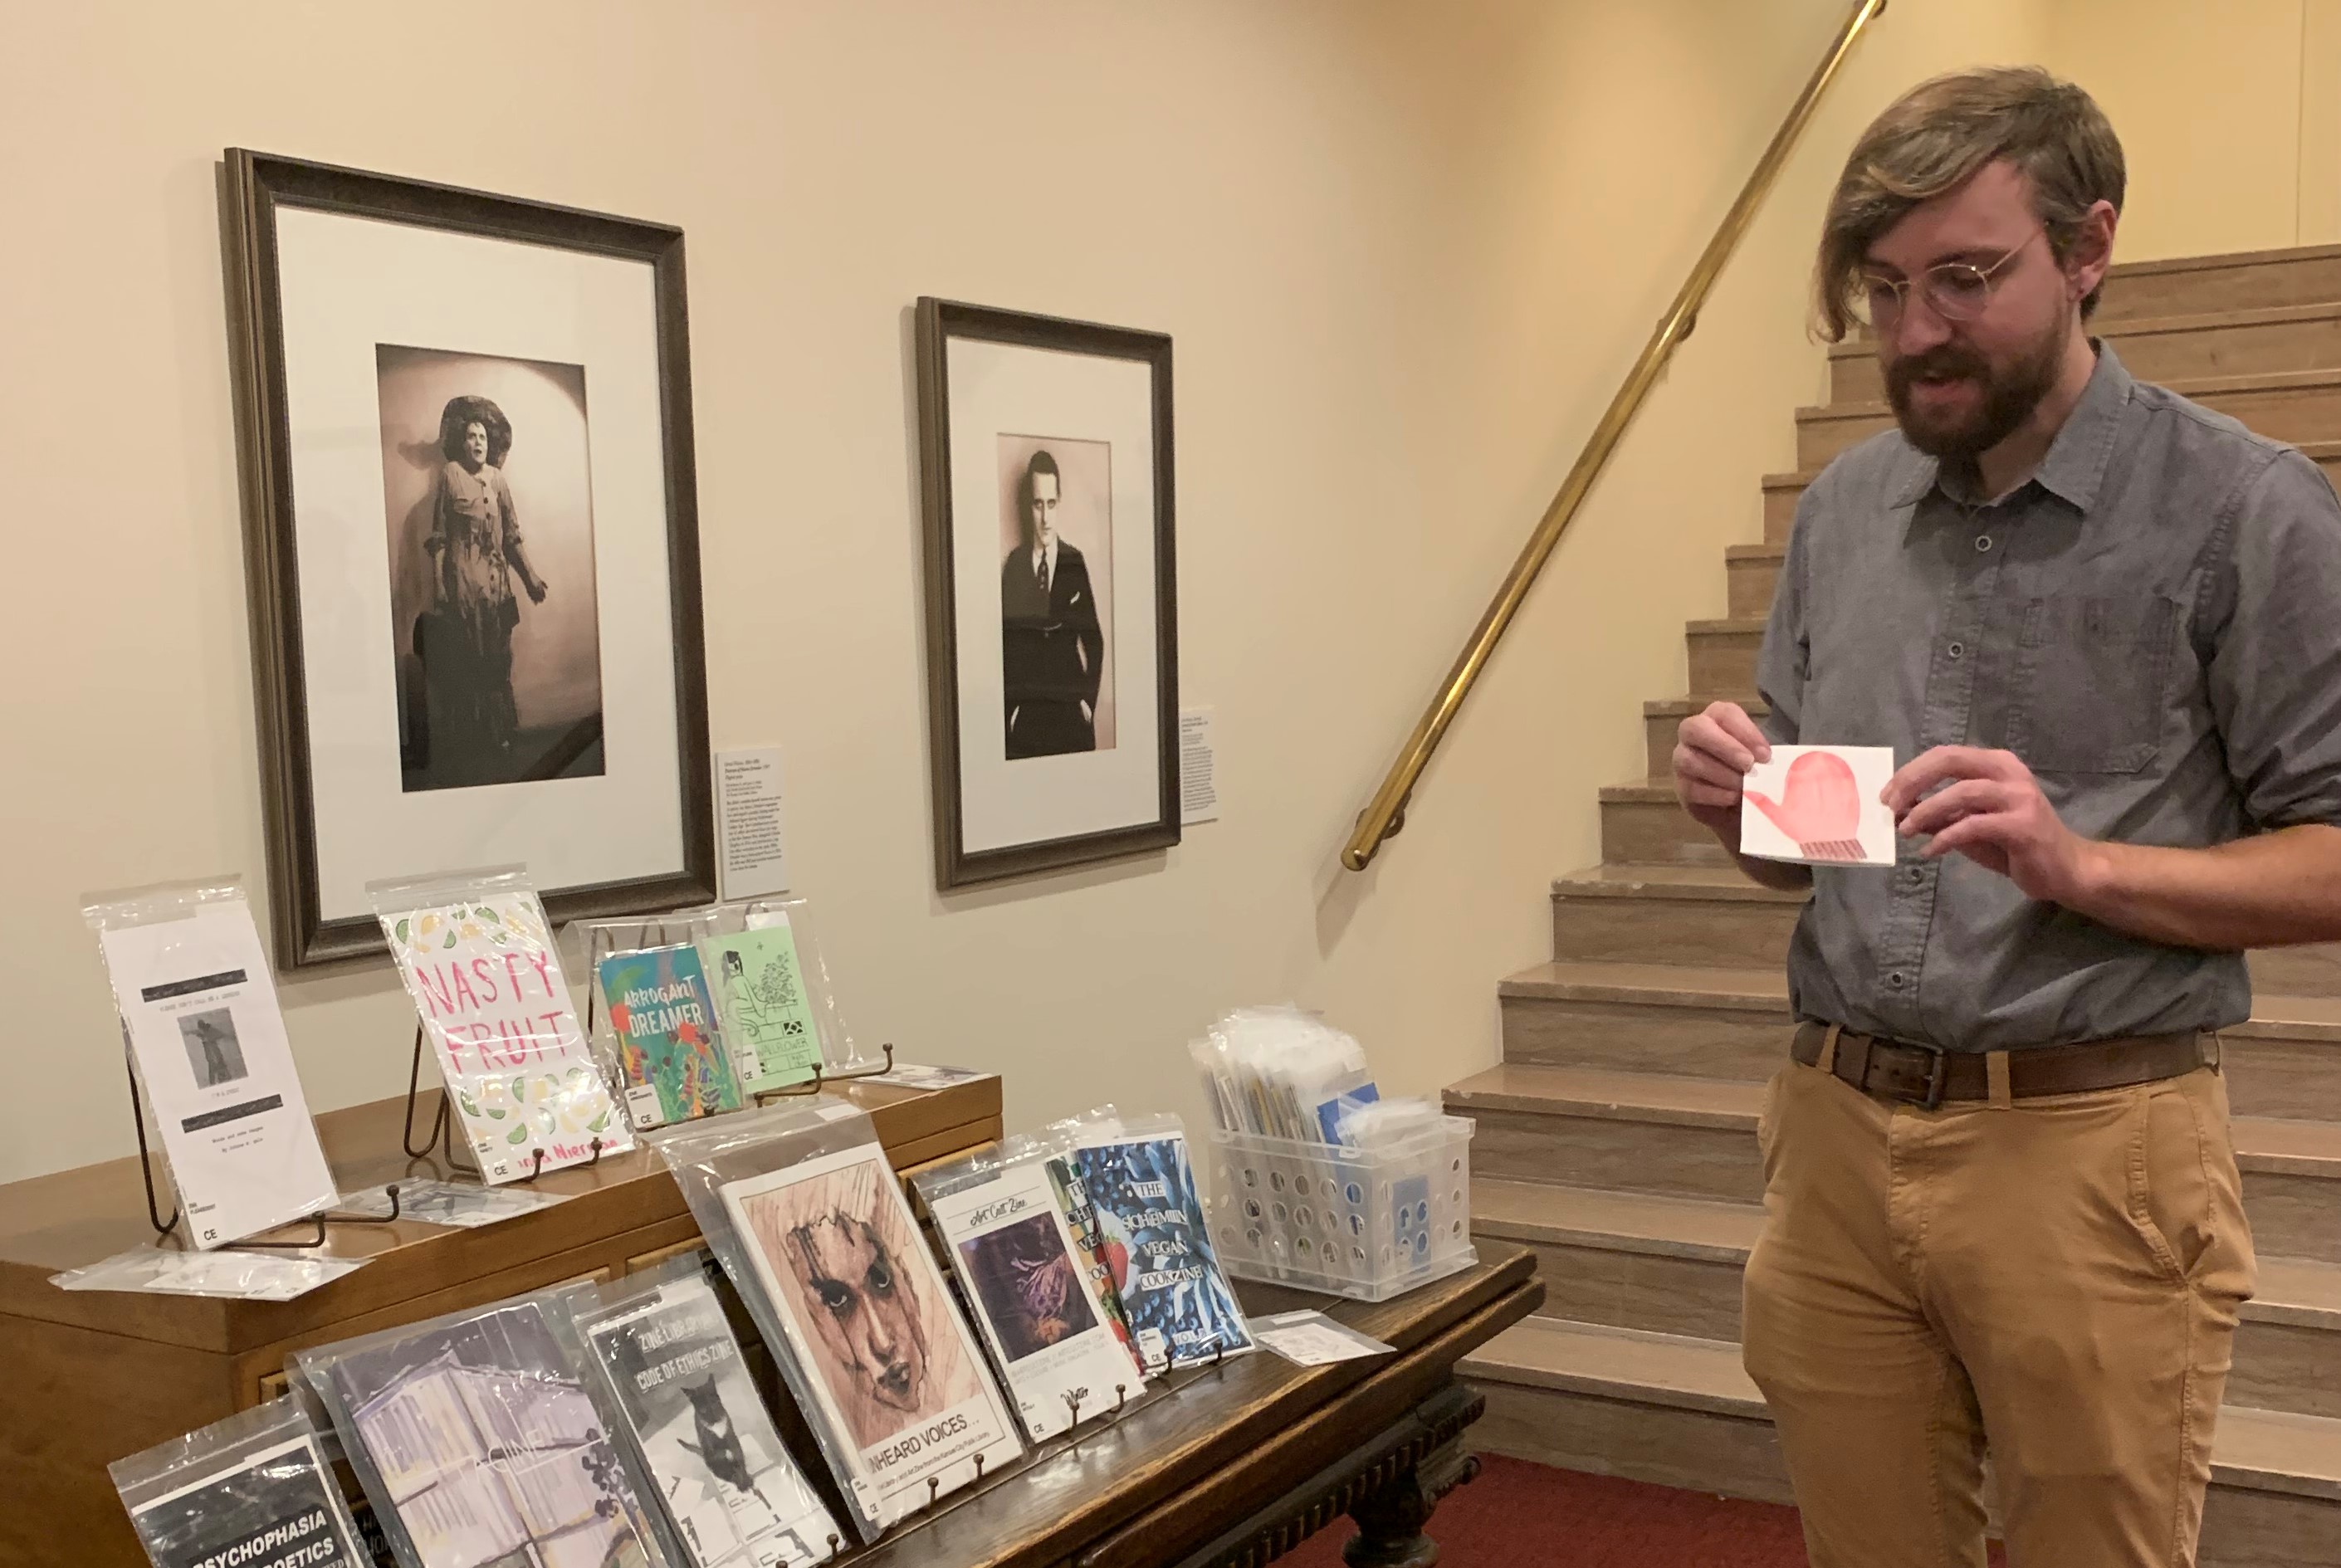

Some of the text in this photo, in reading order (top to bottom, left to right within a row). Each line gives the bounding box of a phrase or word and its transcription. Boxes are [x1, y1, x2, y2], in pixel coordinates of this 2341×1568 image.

[416, 950, 555, 1018] NASTY
[628, 1003, 705, 1038] DREAMER
[445, 1010, 565, 1074] FRUIT
[641, 1114, 652, 1124] CE
[494, 1165, 508, 1176] CE
[1140, 1183, 1163, 1196] THE
[204, 1229, 217, 1240] CE
[1142, 1240, 1189, 1256] VEGAN
[638, 1326, 664, 1351] ZINE
[637, 1339, 734, 1390] CODE OF ETHICS ZINE
[1151, 1353, 1161, 1362] CE
[1034, 1423, 1044, 1434] CE
[868, 1437, 921, 1474] NHEARD
[262, 1537, 335, 1568] OETICS
